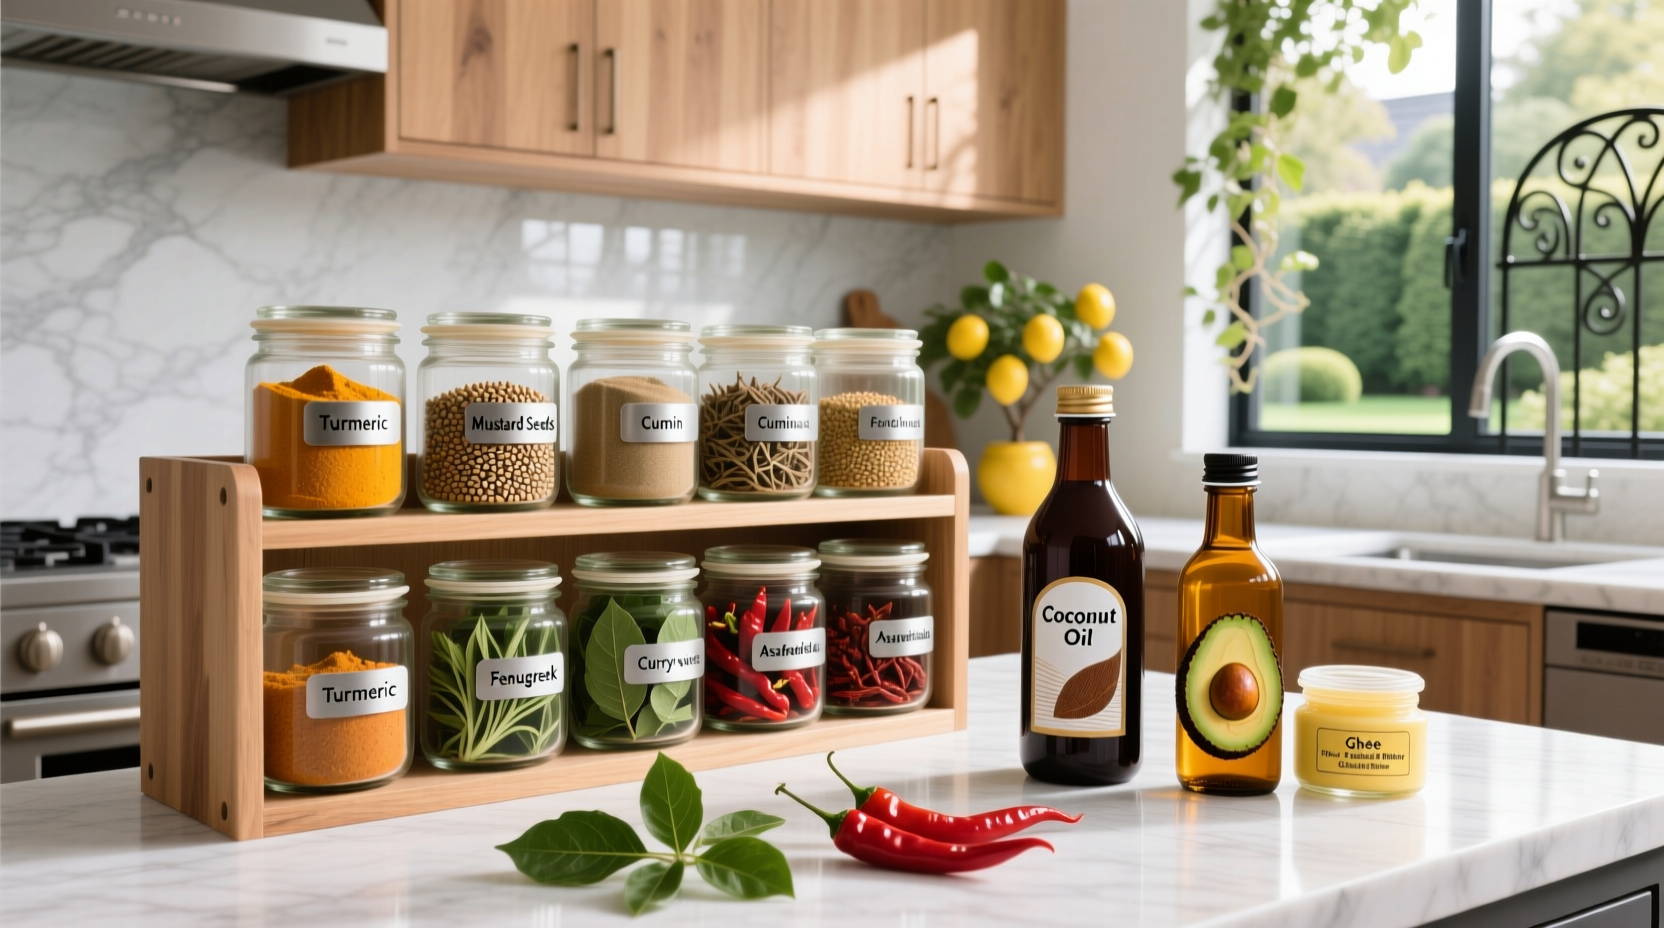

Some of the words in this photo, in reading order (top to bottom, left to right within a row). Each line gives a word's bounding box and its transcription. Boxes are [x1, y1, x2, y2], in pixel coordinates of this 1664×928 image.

[319, 414, 388, 431] Turmeric
[472, 415, 524, 431] Mustard
[641, 415, 683, 430] Cumin
[1042, 605, 1117, 624] Coconut
[1064, 628, 1093, 646] Oil
[322, 681, 397, 703] Turmeric
[1345, 736, 1382, 750] Ghee
